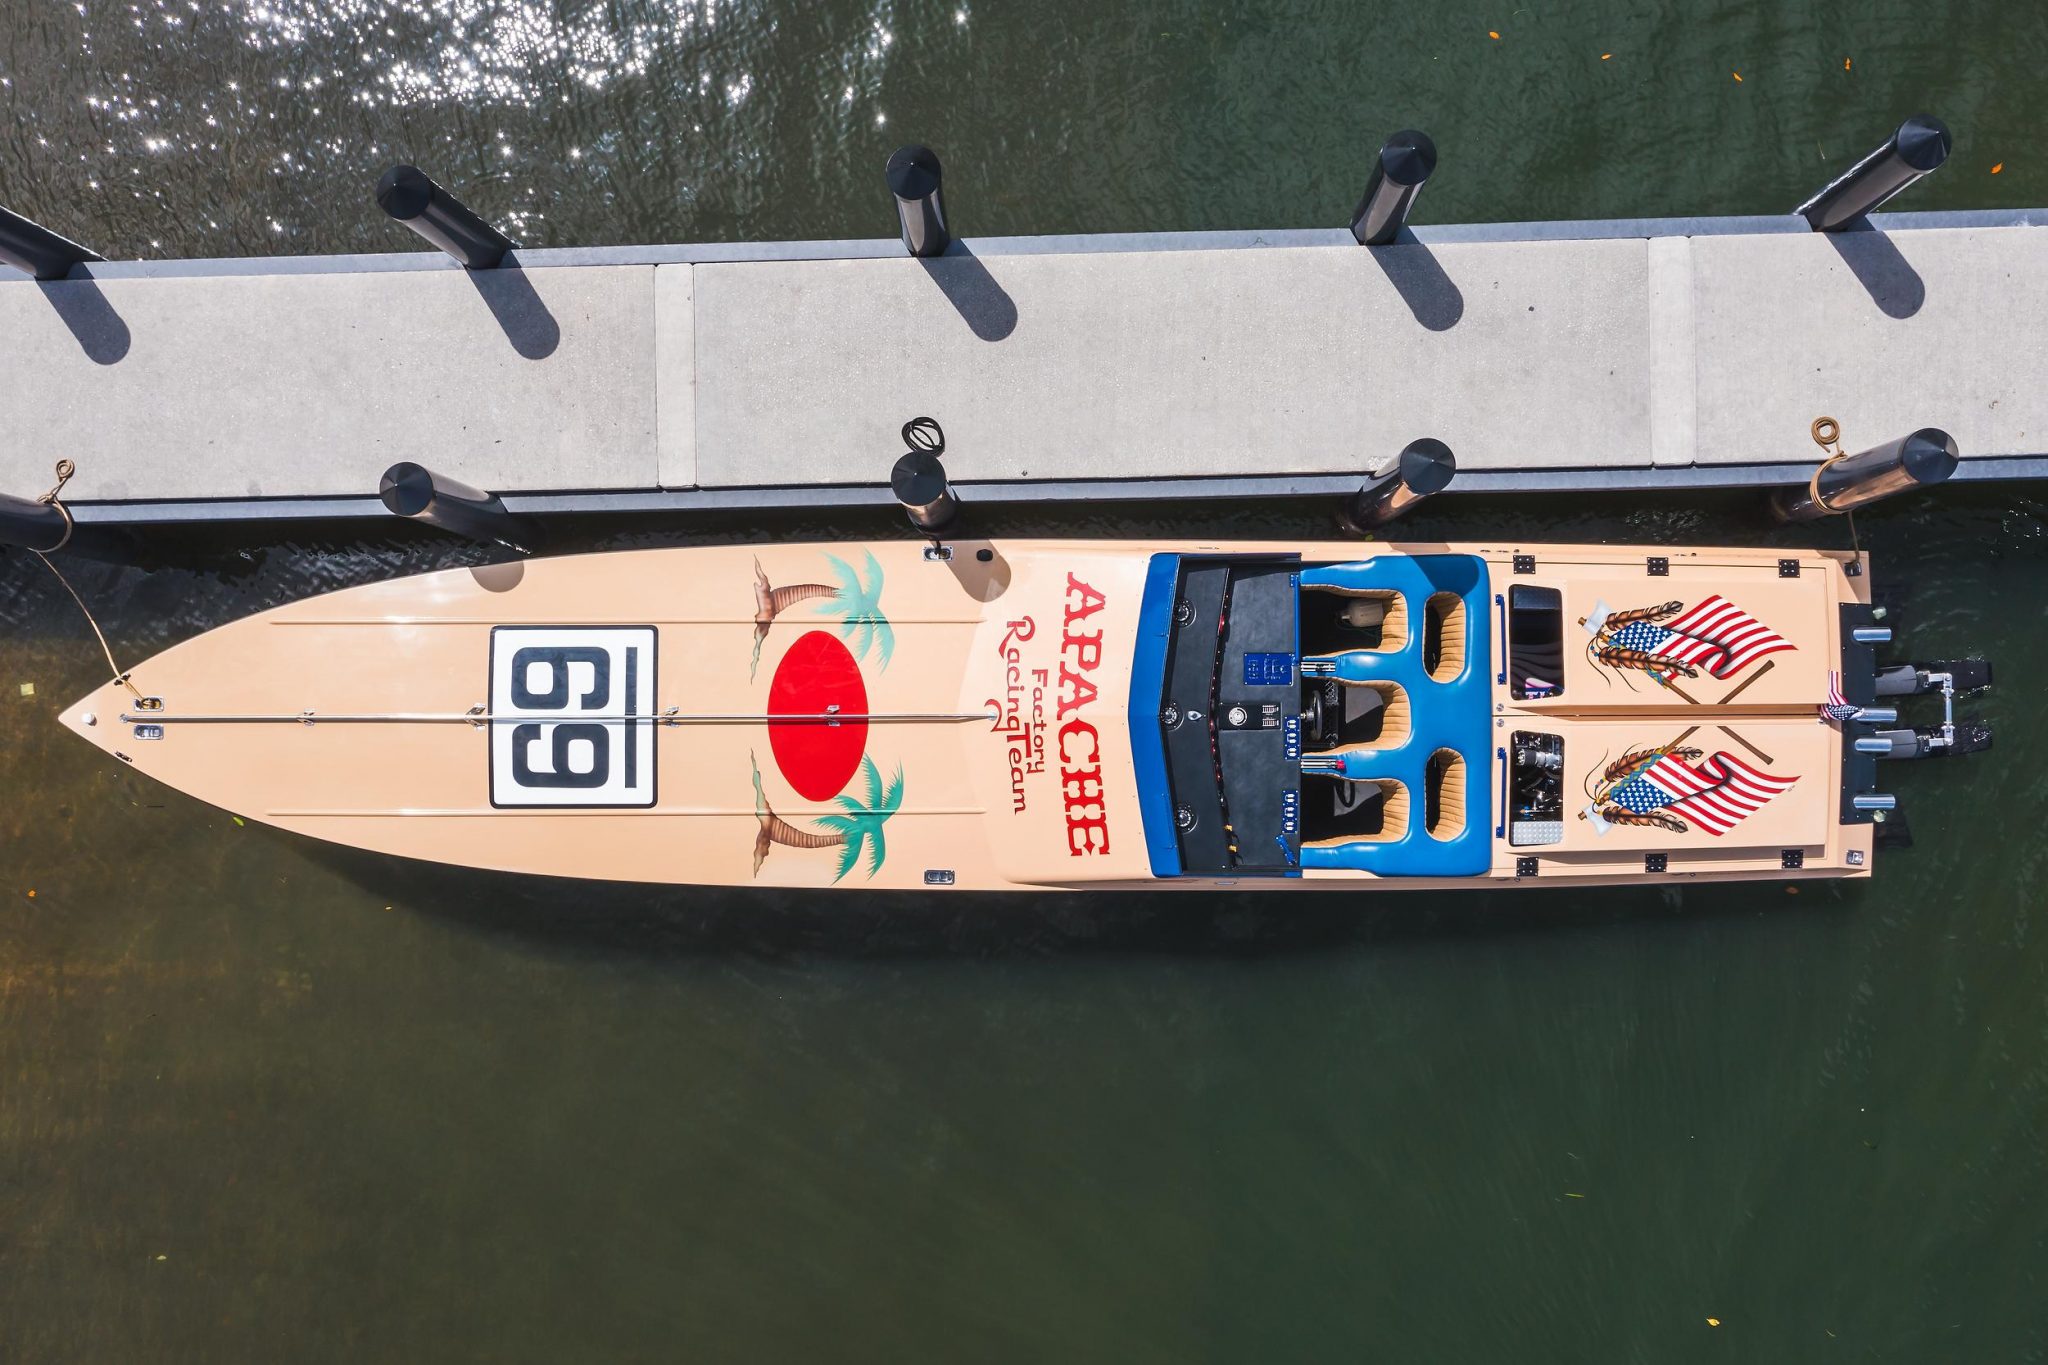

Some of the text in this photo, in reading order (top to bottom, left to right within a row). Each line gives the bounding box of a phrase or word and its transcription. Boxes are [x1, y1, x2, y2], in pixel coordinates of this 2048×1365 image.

[511, 646, 611, 789] 69
[985, 615, 1036, 815] Racing Team
[1026, 668, 1049, 775] Factory
[1056, 571, 1110, 858] APACHE
